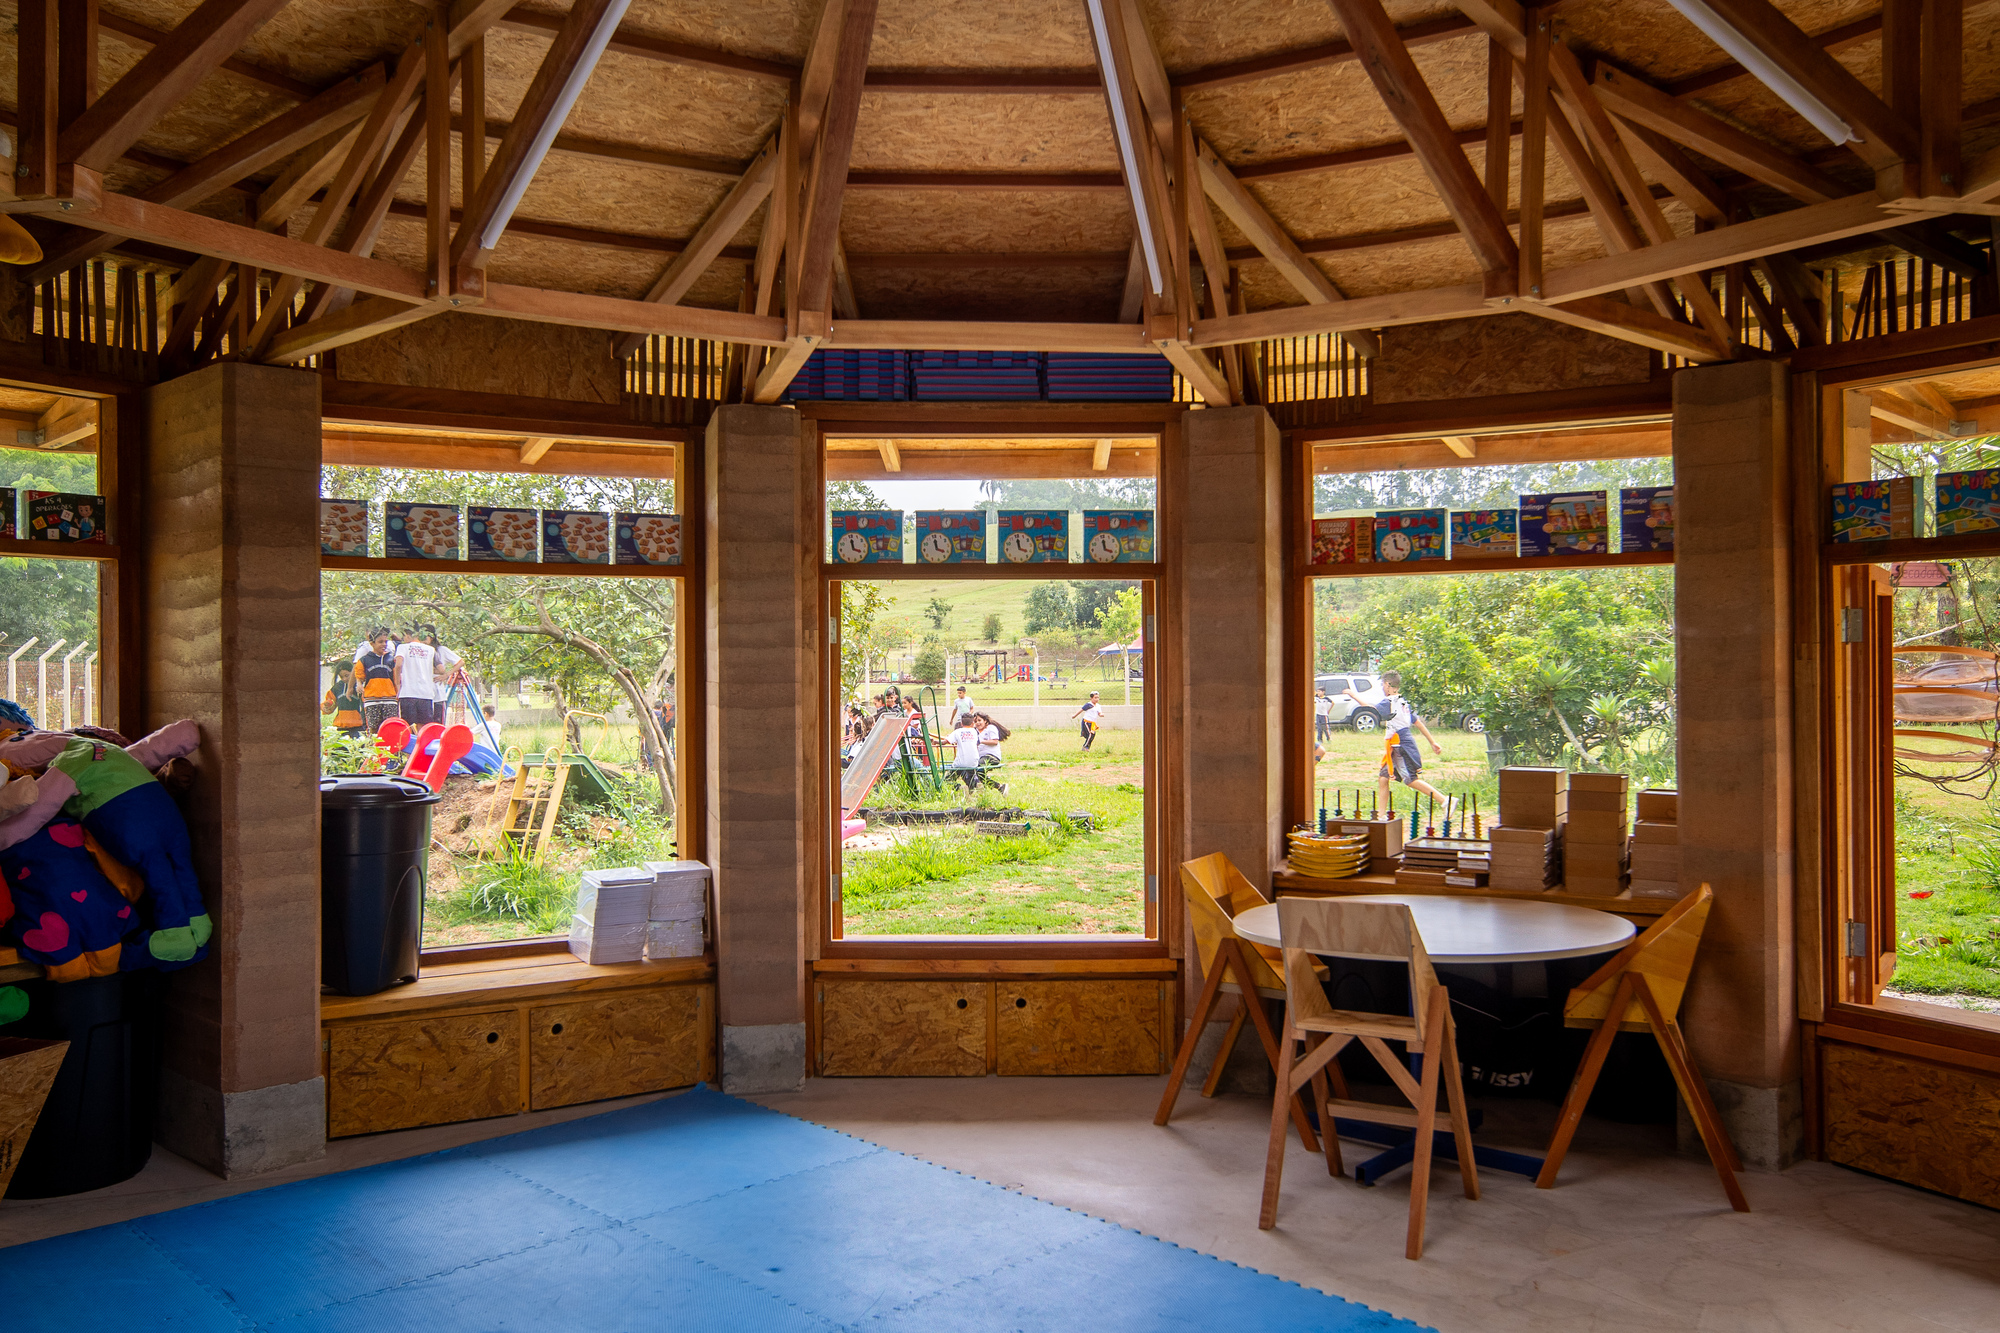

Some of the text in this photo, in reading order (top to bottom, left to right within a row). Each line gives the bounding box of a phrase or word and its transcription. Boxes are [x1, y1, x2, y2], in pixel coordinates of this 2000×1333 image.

[1953, 470, 1999, 490] FRUTAS
[1848, 482, 1889, 499] FRUTAS
[845, 515, 897, 531] HORAS
[929, 515, 980, 531] HORAS
[1011, 515, 1063, 531] HORAS
[1097, 515, 1148, 532] HORAS
[1388, 515, 1439, 530] HORAS
[1464, 511, 1499, 525] FRUTAS
